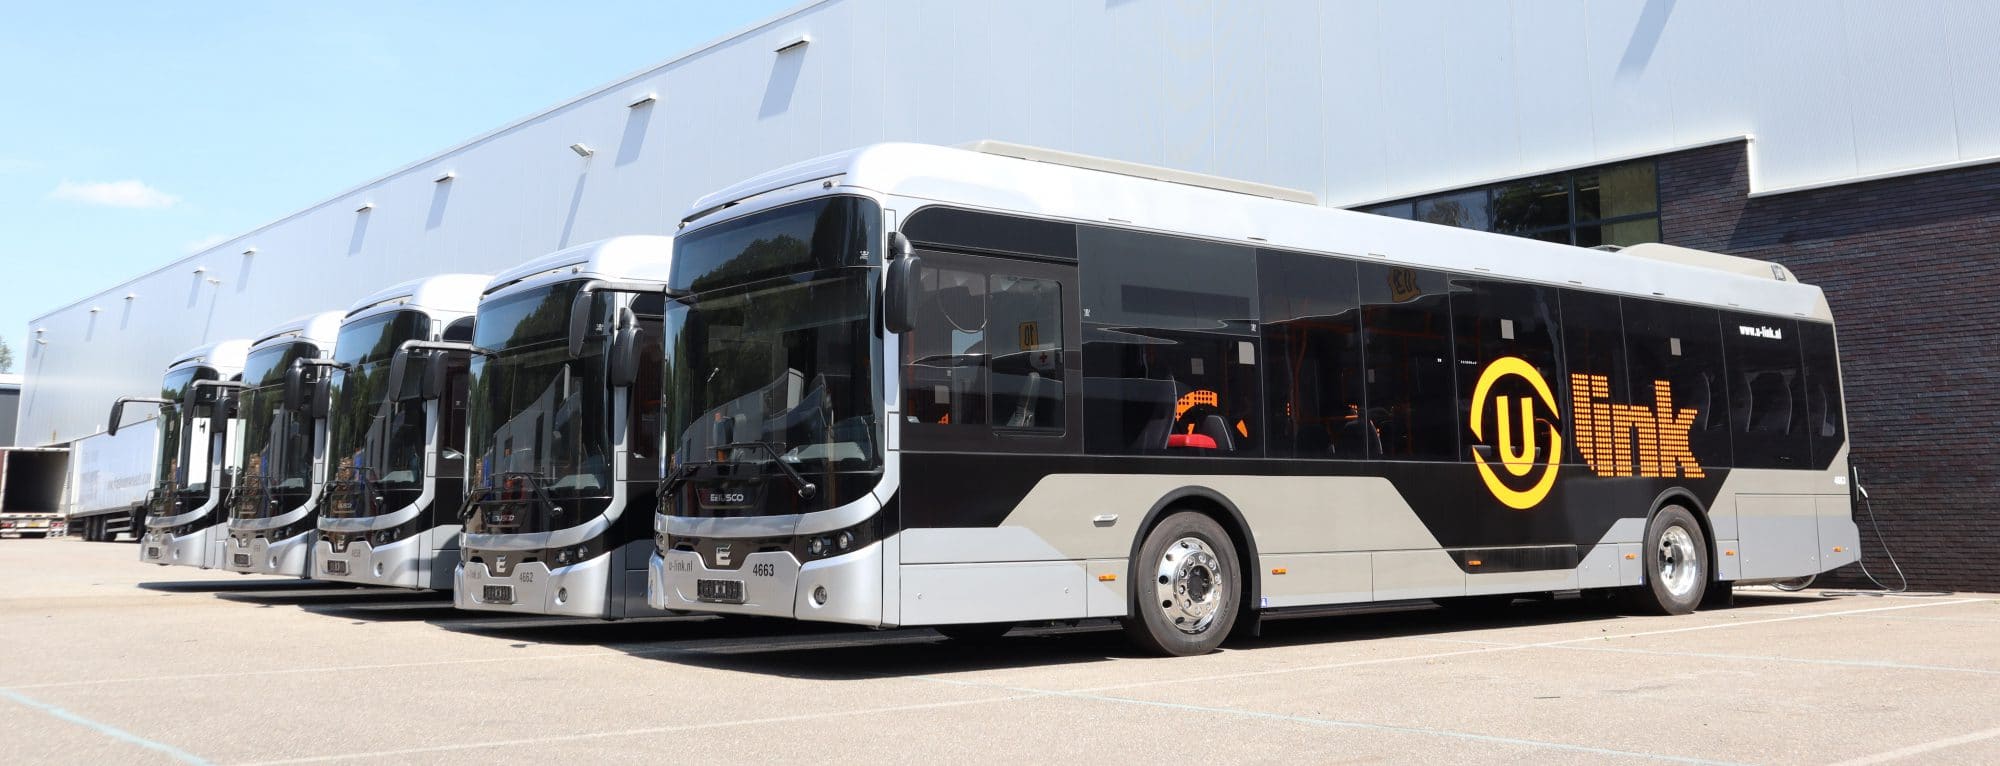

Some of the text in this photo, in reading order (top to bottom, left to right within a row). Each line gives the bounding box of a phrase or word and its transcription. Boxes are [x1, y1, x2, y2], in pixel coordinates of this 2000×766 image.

[1571, 373, 1706, 479] link
[710, 493, 744, 502] EBUSCO
[752, 563, 775, 577] 4663
